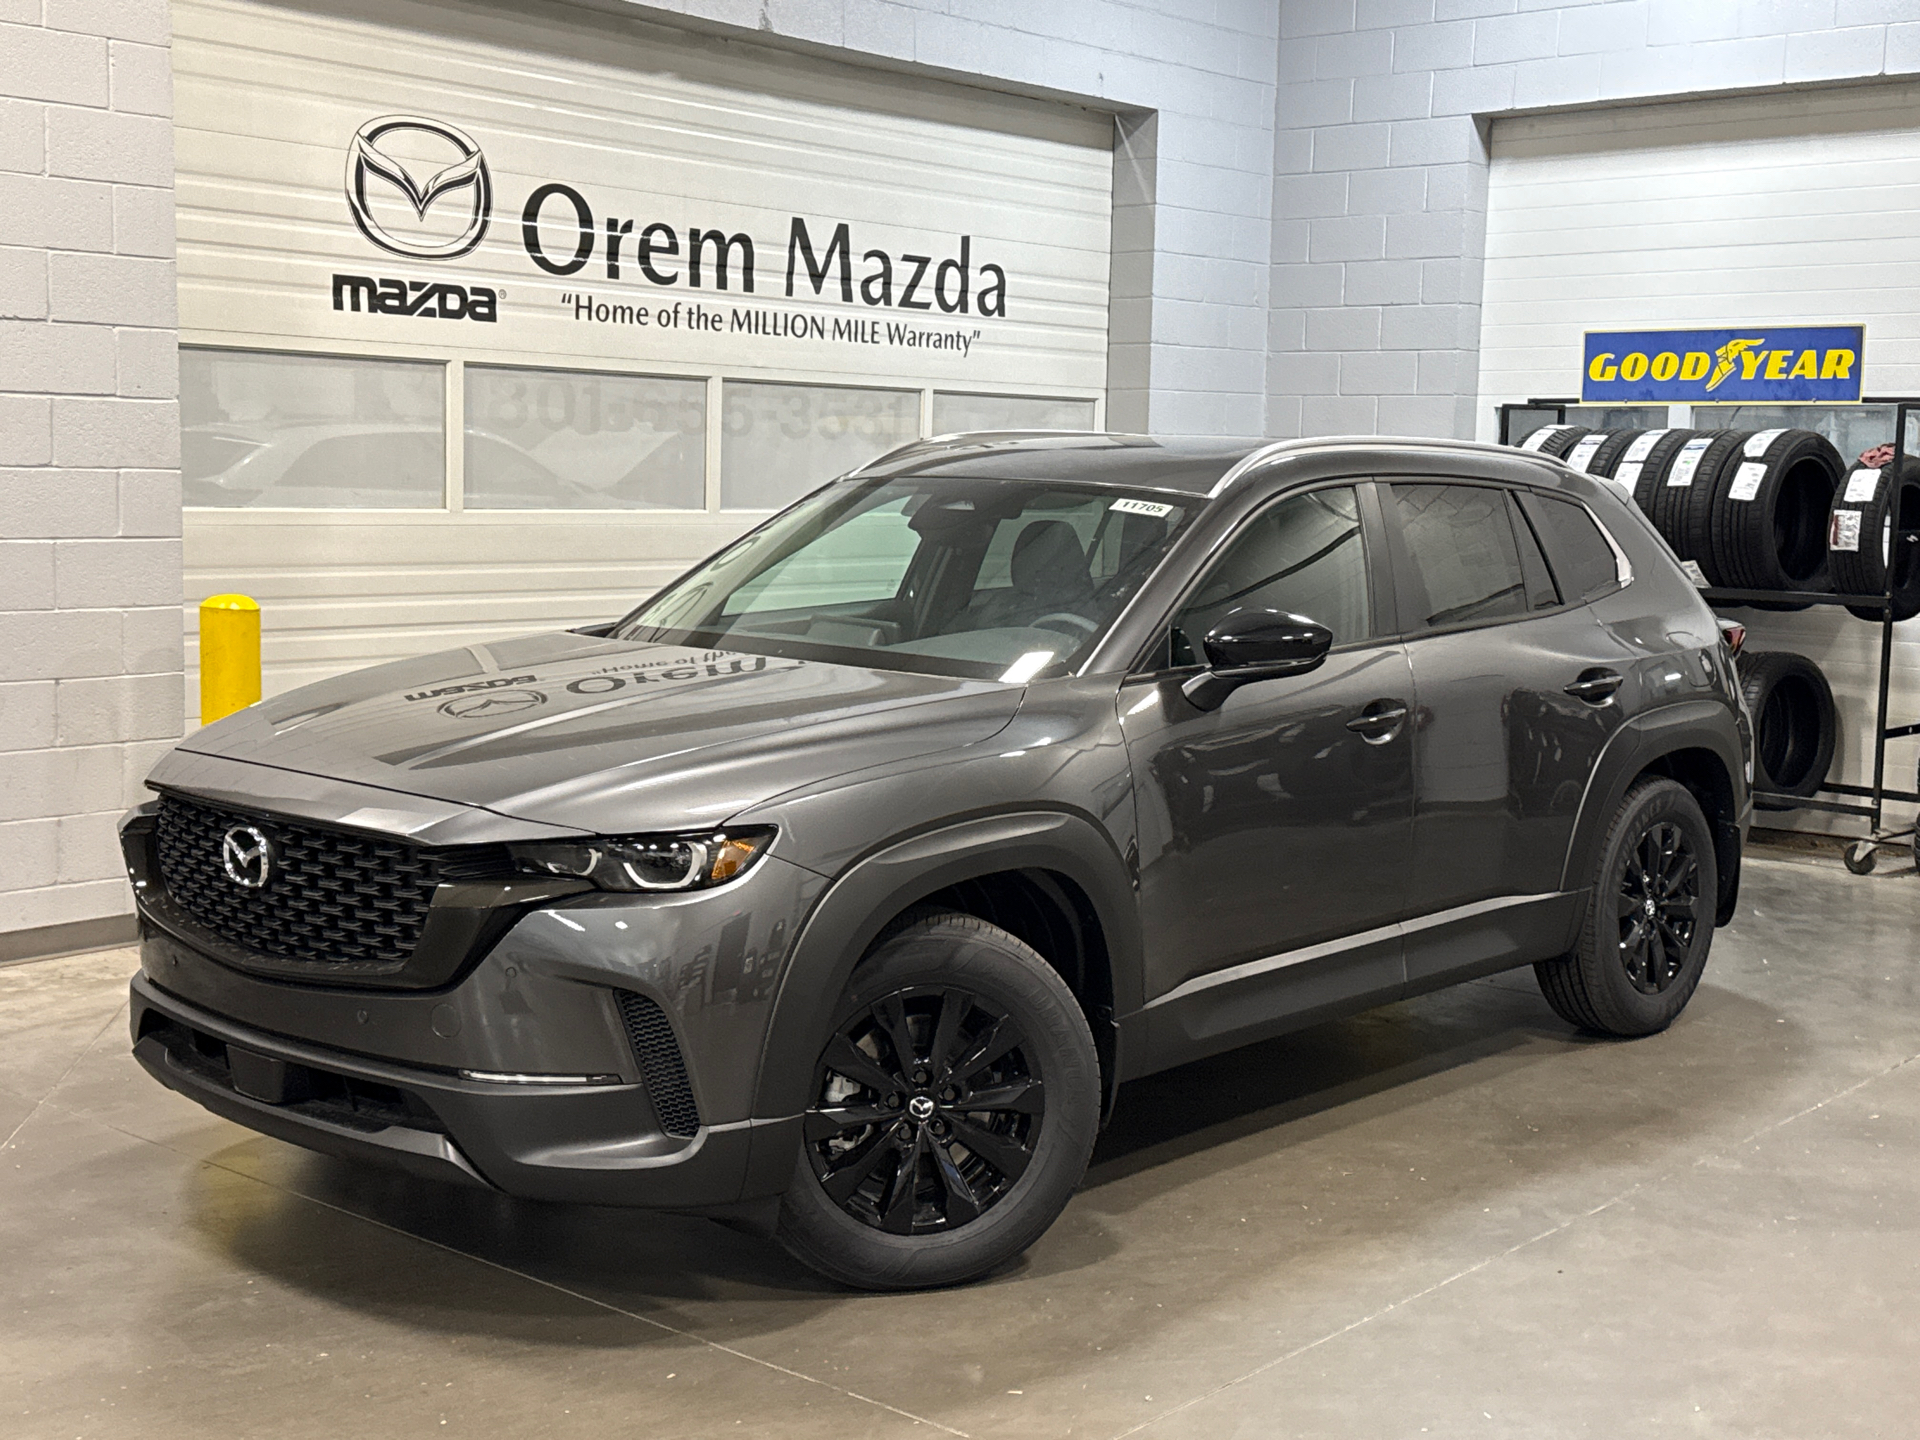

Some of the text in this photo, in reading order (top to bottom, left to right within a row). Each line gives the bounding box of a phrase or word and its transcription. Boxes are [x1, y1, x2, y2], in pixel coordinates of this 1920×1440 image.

[521, 183, 1007, 318] Orem Mazda
[656, 302, 683, 328] of
[686, 304, 724, 332] the
[730, 308, 826, 341] MILLION
[832, 316, 881, 345] MILE
[1122, 501, 1163, 513] 11705
